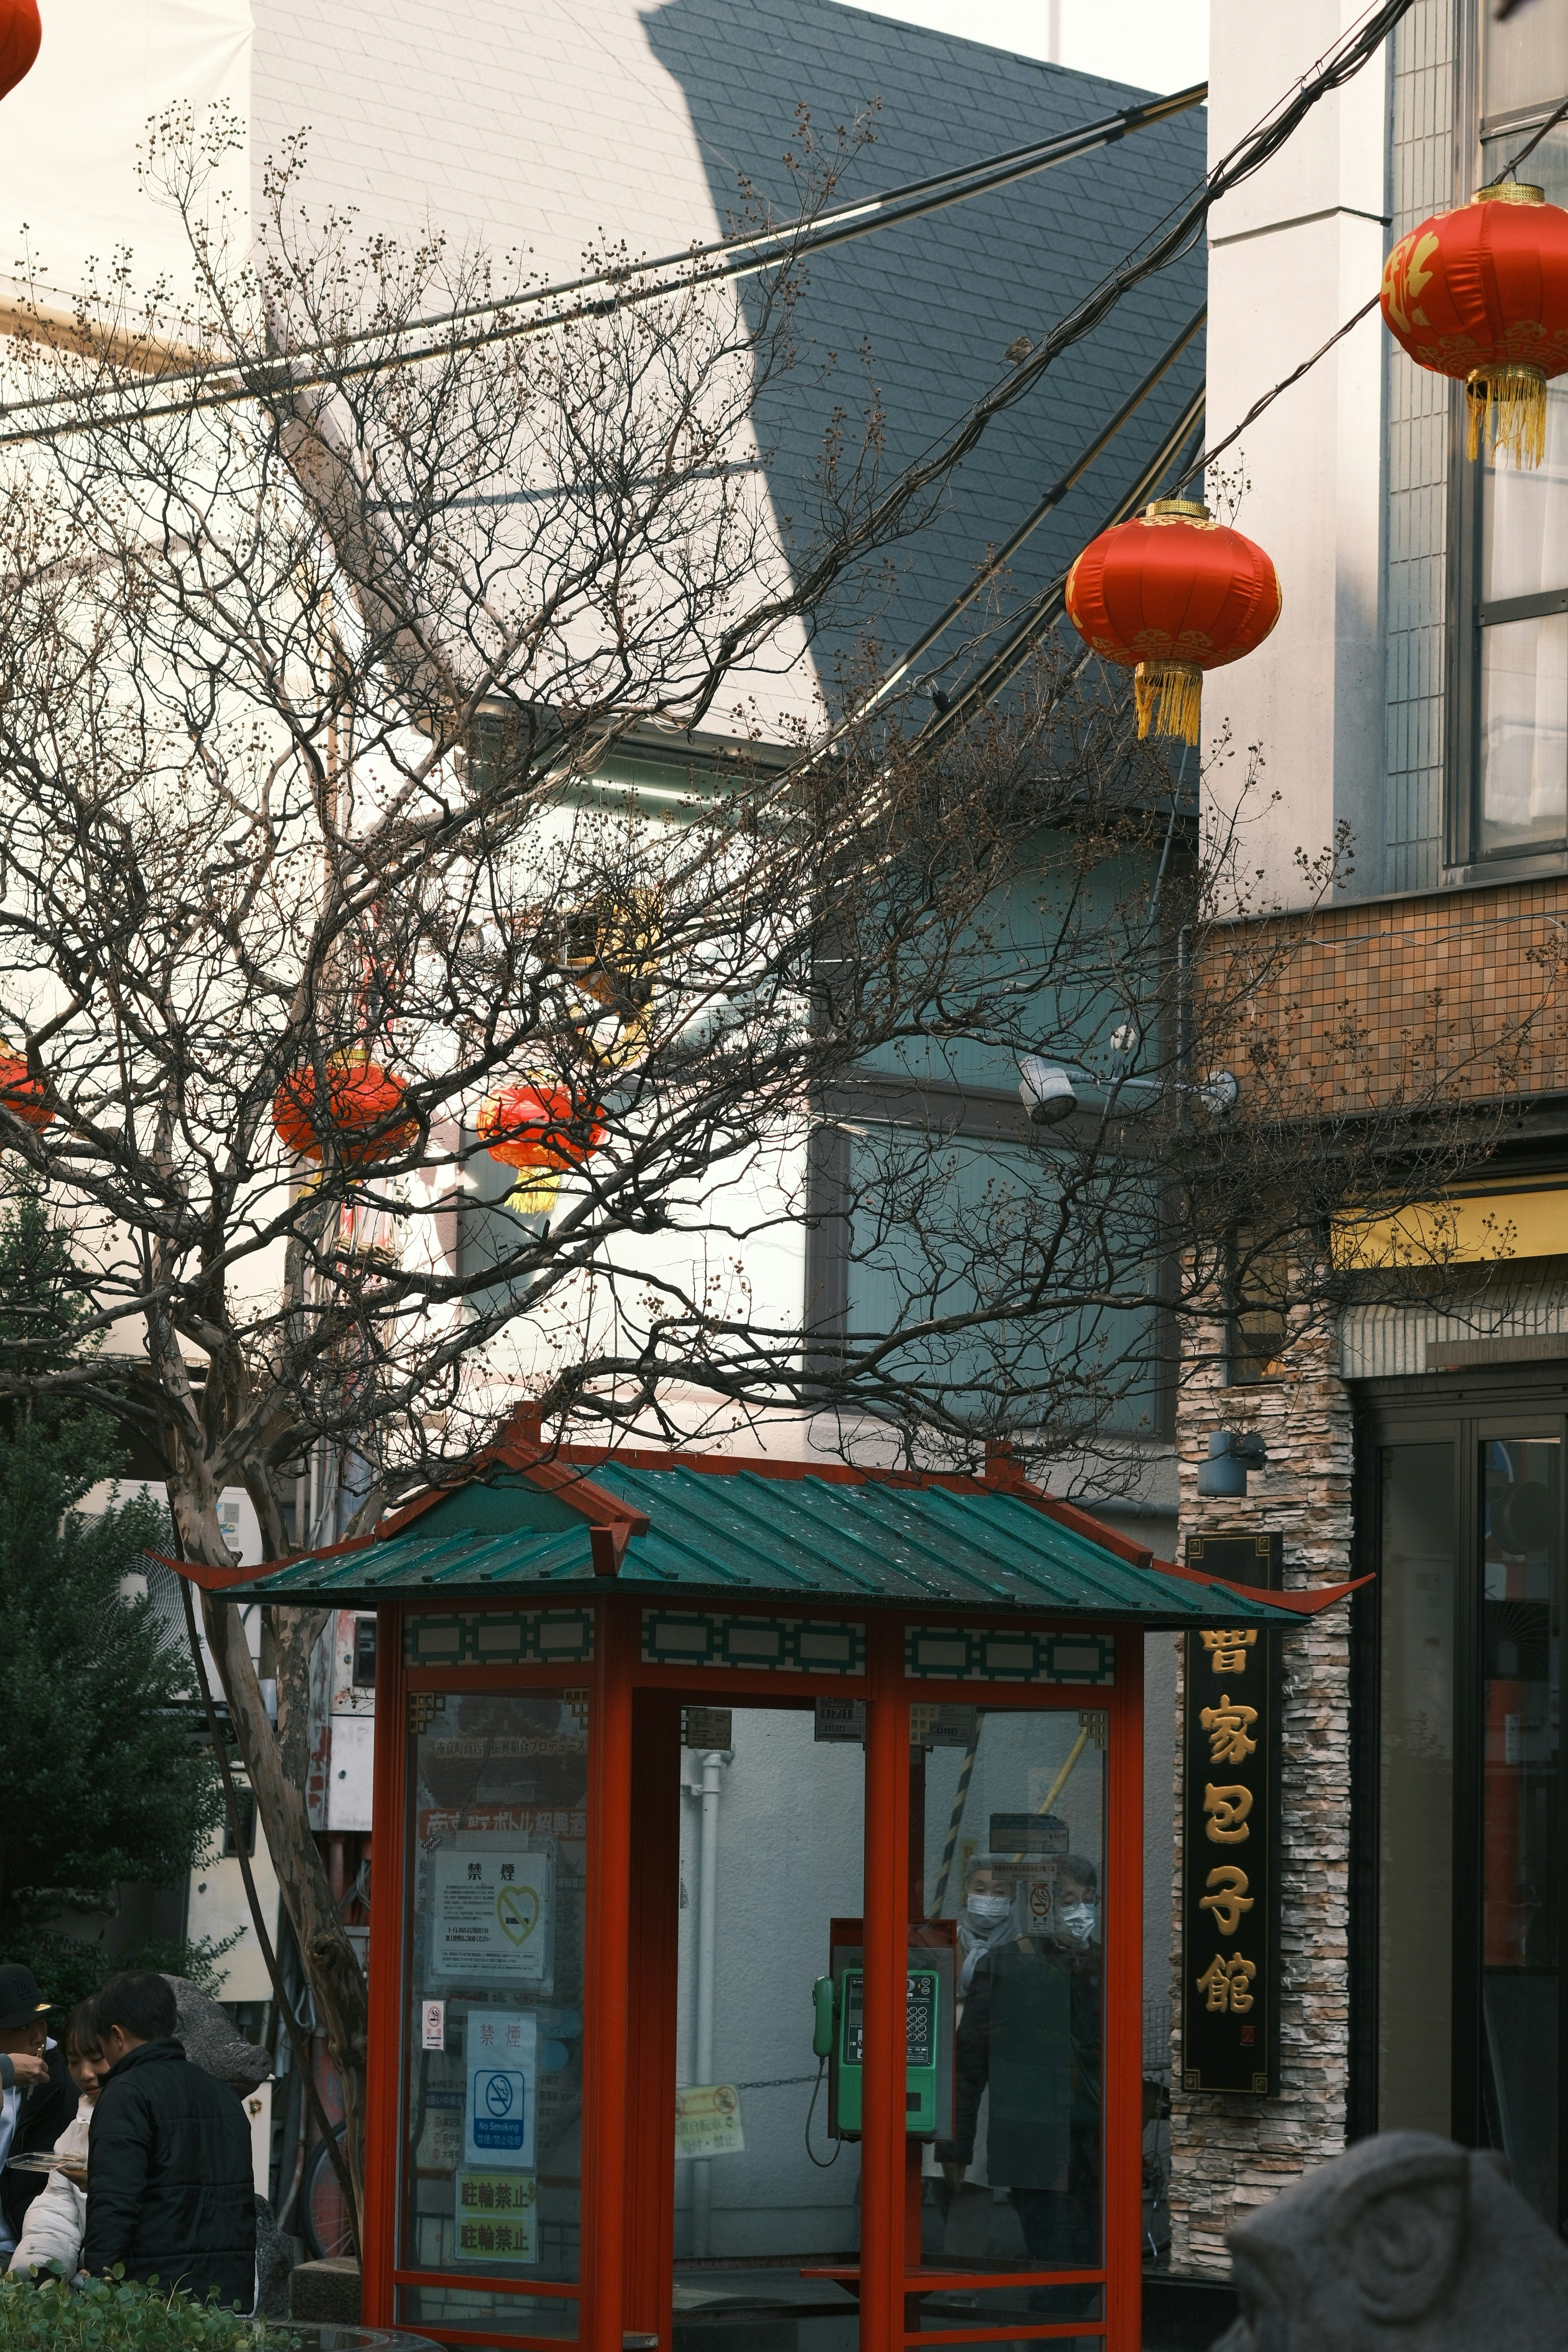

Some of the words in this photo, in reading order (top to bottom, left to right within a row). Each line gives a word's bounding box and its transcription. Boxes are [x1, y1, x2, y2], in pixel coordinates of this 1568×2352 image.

[823, 1709, 850, 1718] 171
[468, 1863, 514, 1881] 禁煙
[479, 2023, 520, 2047] 禁煙
[479, 2122, 489, 2130] No
[489, 2122, 519, 2133] Smoking
[461, 2182, 529, 2209] 駐輪禁止
[461, 2224, 529, 2252] 駐輪禁止
